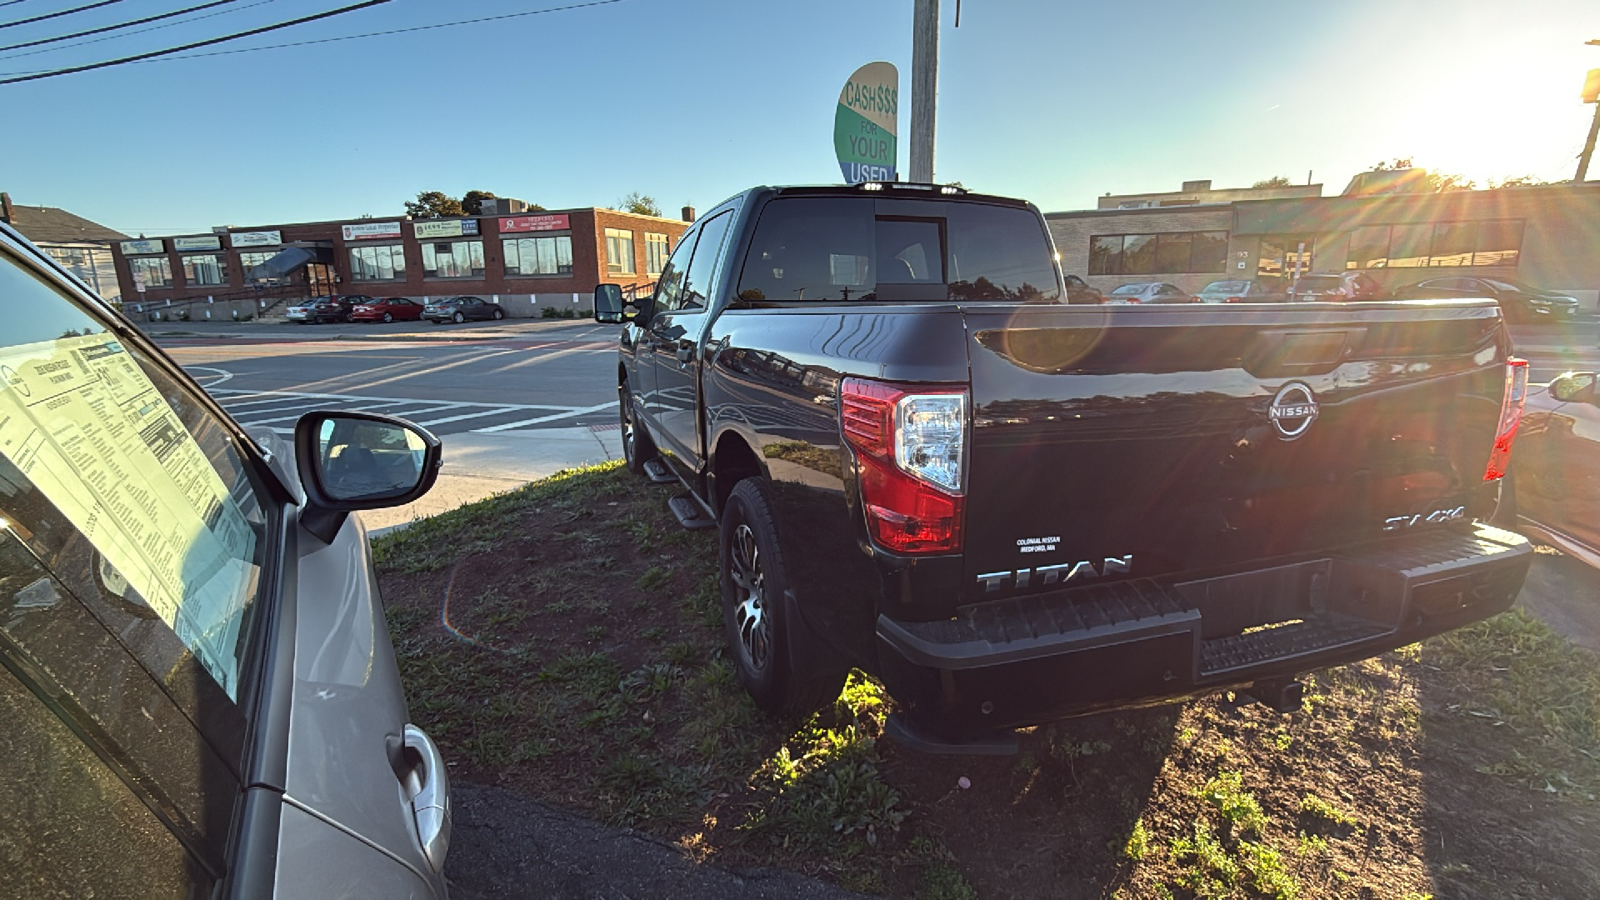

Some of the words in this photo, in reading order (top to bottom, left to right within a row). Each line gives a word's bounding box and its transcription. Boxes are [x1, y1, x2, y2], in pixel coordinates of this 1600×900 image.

[845, 81, 897, 118] CASH$$$
[861, 121, 877, 136] FOR
[849, 134, 887, 161] YOUR
[851, 162, 888, 183] USED
[1271, 406, 1316, 417] NISSAN
[1016, 537, 1041, 546] COLONIAL
[1041, 536, 1061, 544] NISSAN
[976, 554, 1133, 593] TITAN
